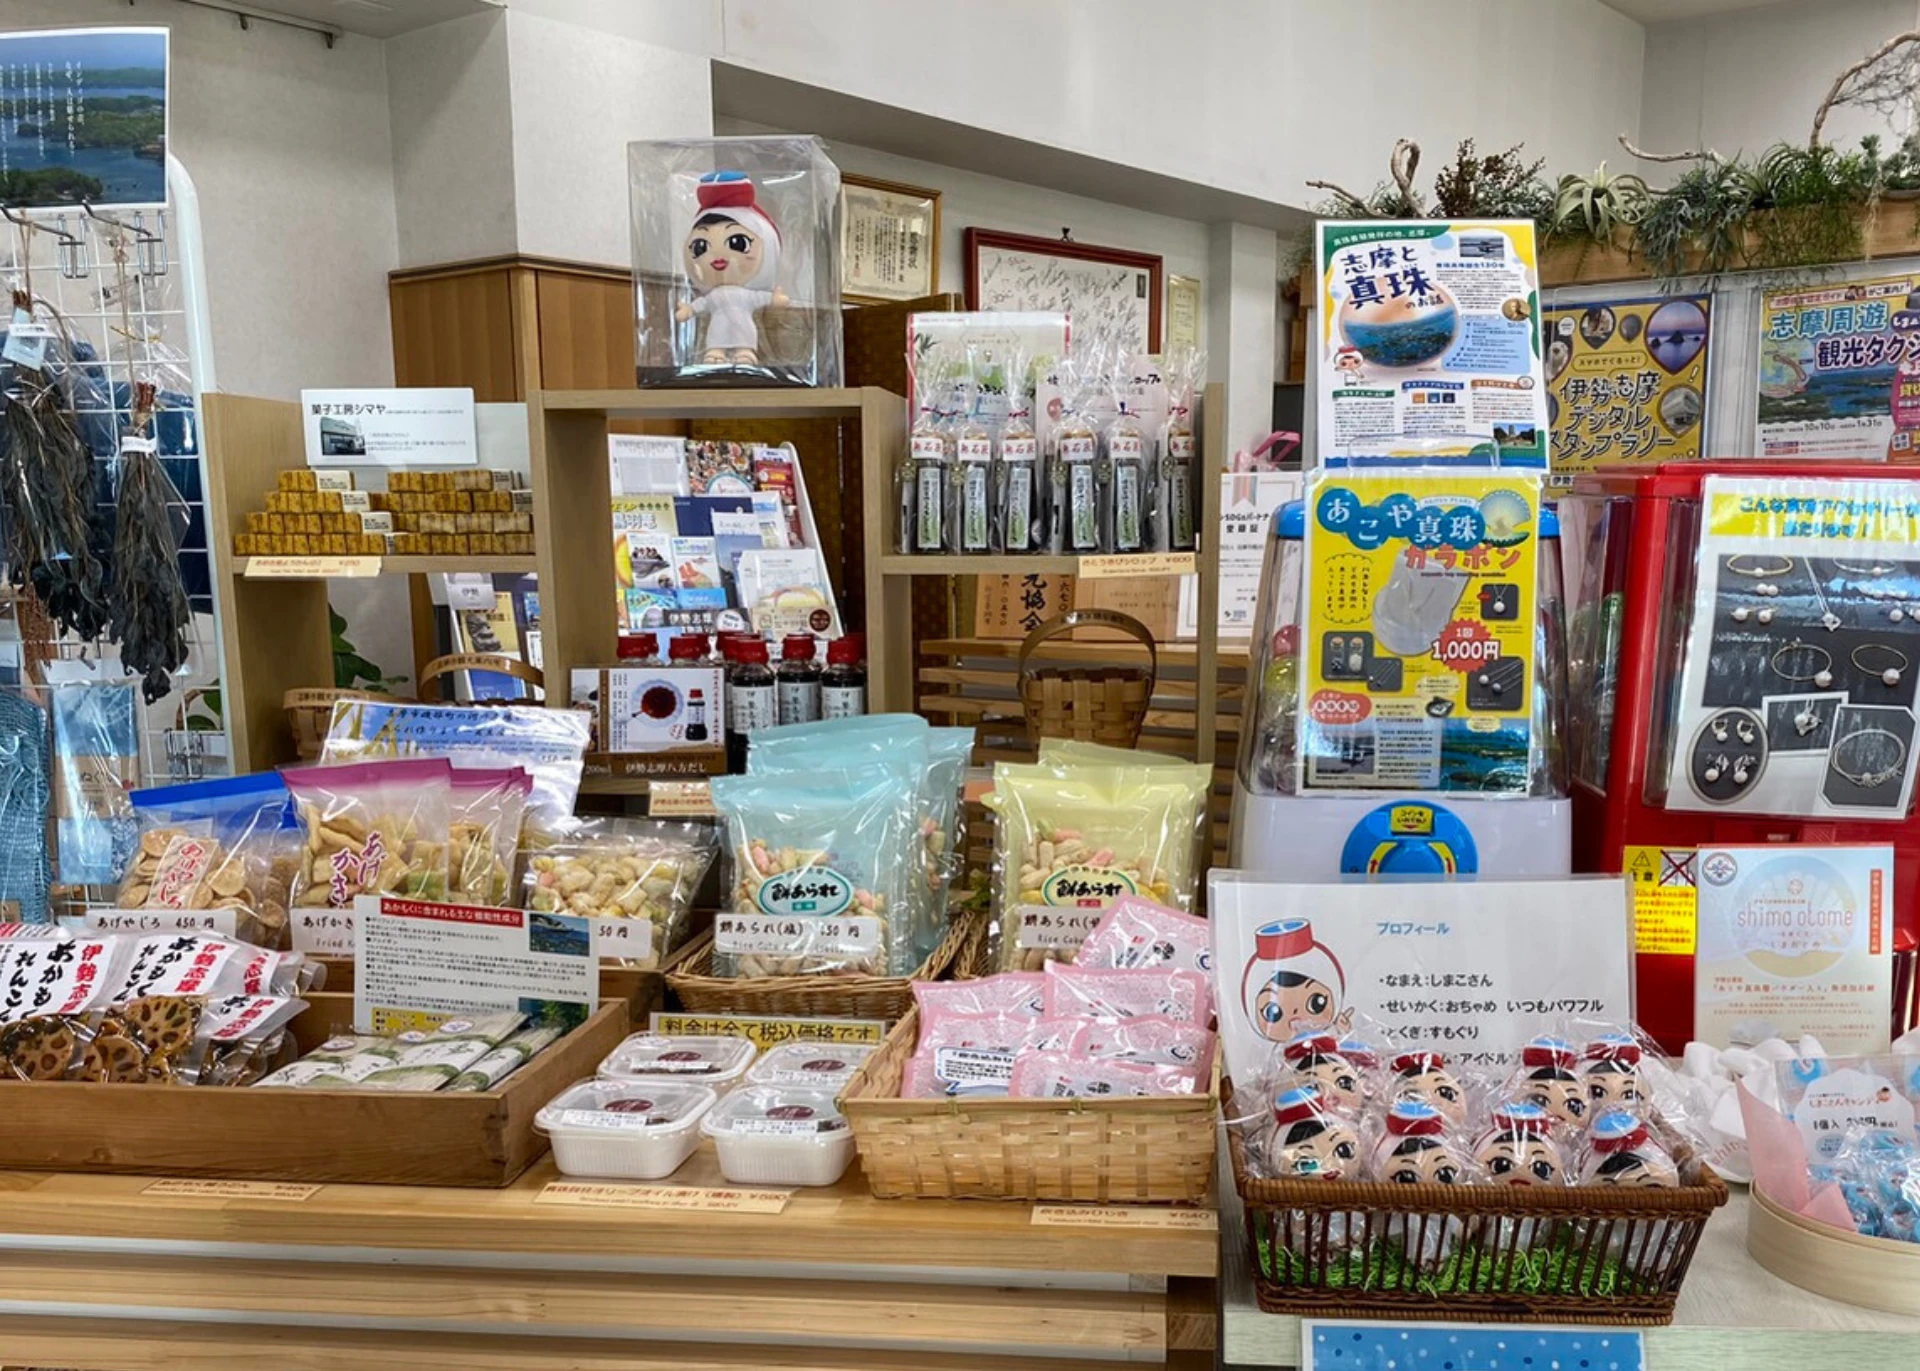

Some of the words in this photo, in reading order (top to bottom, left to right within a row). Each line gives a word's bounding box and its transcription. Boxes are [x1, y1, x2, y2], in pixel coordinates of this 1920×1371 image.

[1340, 244, 1417, 275] 志摩と
[1345, 267, 1435, 309] 真珠
[1405, 294, 1444, 309] のお話
[1769, 302, 1888, 339] 志摩周遊
[1559, 371, 1661, 406] 伊勢志摩
[311, 404, 386, 415] 菓子工房シマヤ
[1566, 406, 1652, 433] デジタル
[1550, 427, 1675, 460] スタンプラリー
[1327, 498, 1478, 543] あこや真珠
[1404, 543, 1521, 570] ガラポン
[1456, 628, 1474, 637] 1回
[1432, 641, 1500, 660] 1,000円
[358, 832, 387, 885] あげ
[771, 882, 840, 901] 餅あられ
[97, 916, 161, 928] あげやじろ
[175, 918, 195, 928] 450
[203, 918, 214, 929] 円
[382, 902, 521, 925] あかもくに含まれる主な機能性成分
[1737, 901, 1792, 927] shima
[1797, 901, 1853, 927] otome
[848, 925, 860, 938] 円
[1377, 922, 1450, 936] プロフィール
[1506, 999, 1604, 1013] いつもパワフル
[664, 1019, 874, 1042] 料金は全て税込価格です
